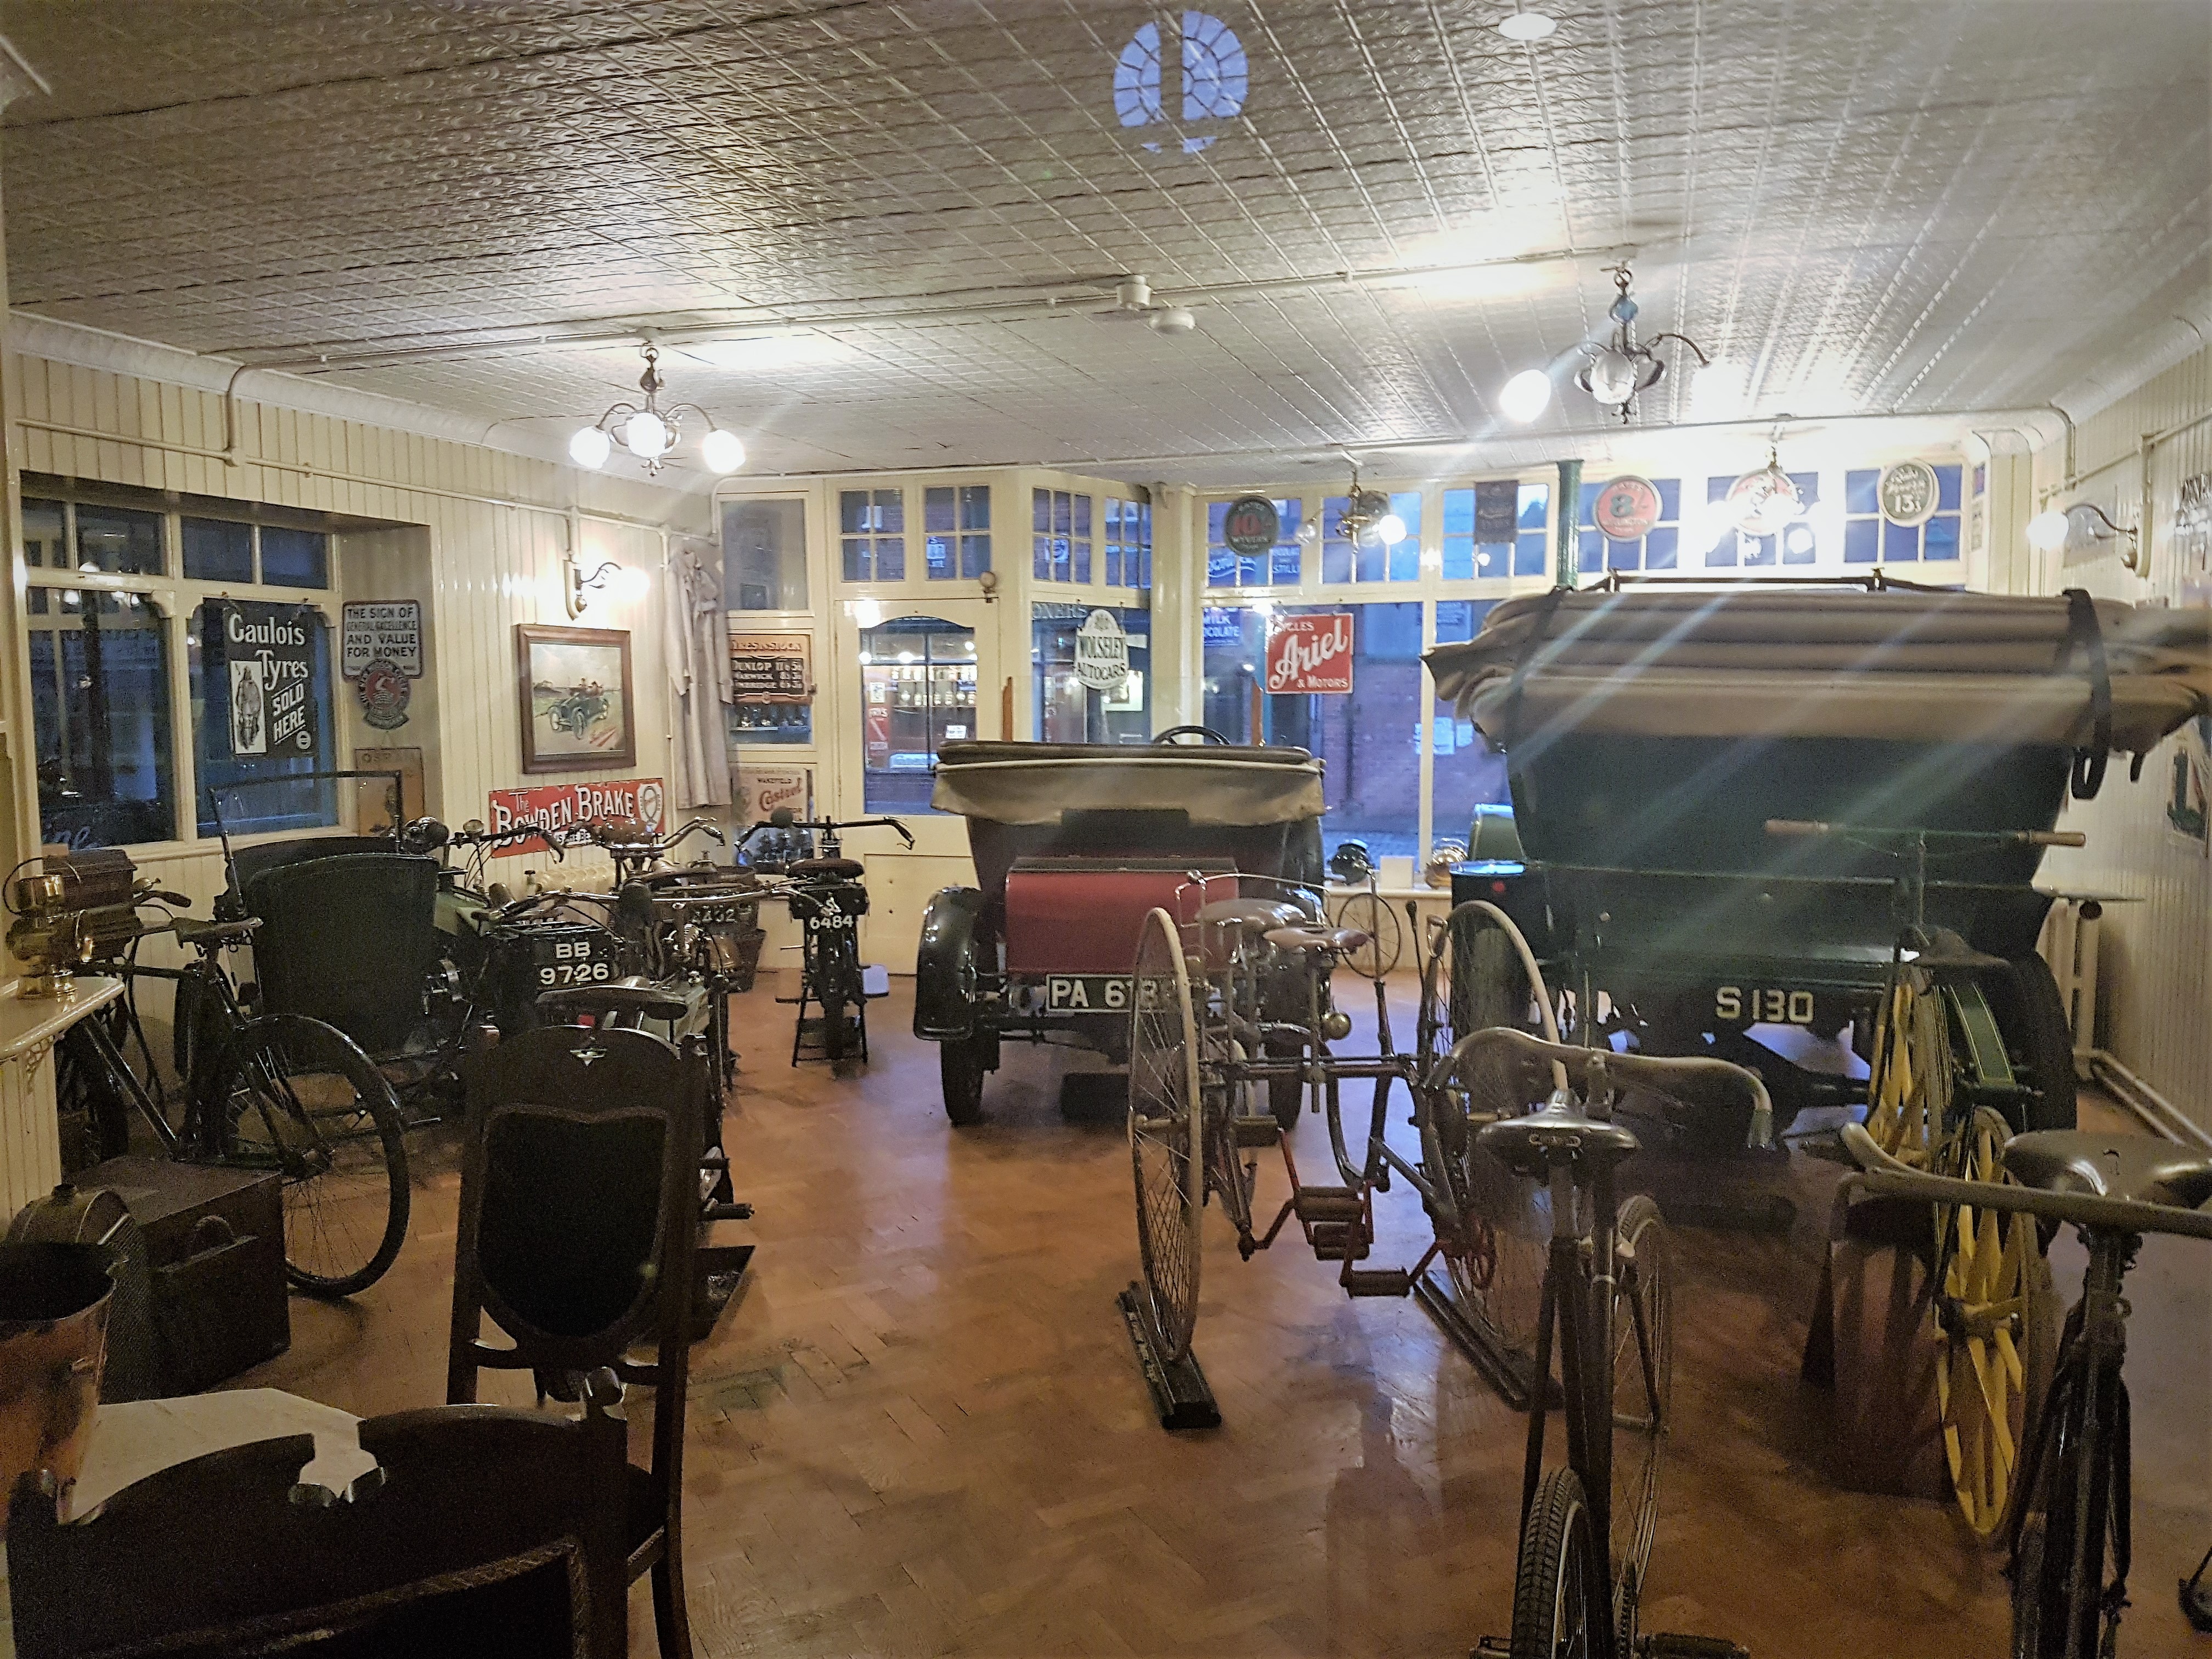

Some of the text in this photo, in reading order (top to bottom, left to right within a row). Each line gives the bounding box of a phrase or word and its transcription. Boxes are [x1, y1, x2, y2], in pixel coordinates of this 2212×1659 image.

[347, 607, 414, 619] THE SIGN OF
[229, 613, 306, 646] Gaulois
[347, 633, 416, 645] AND VALUE
[347, 646, 417, 657] FOR MONEY
[1269, 617, 1348, 690] Ariel
[254, 649, 309, 691] Tyres
[1077, 662, 1126, 680] AUTOCARS
[273, 683, 304, 716] SOLD
[274, 705, 306, 740] HERE
[492, 797, 573, 849] BOWDEN
[574, 784, 636, 822] BRAKE
[810, 915, 854, 930] 6484
[556, 941, 591, 958] BB
[540, 963, 609, 985] 9726
[1051, 979, 1090, 1008] PA
